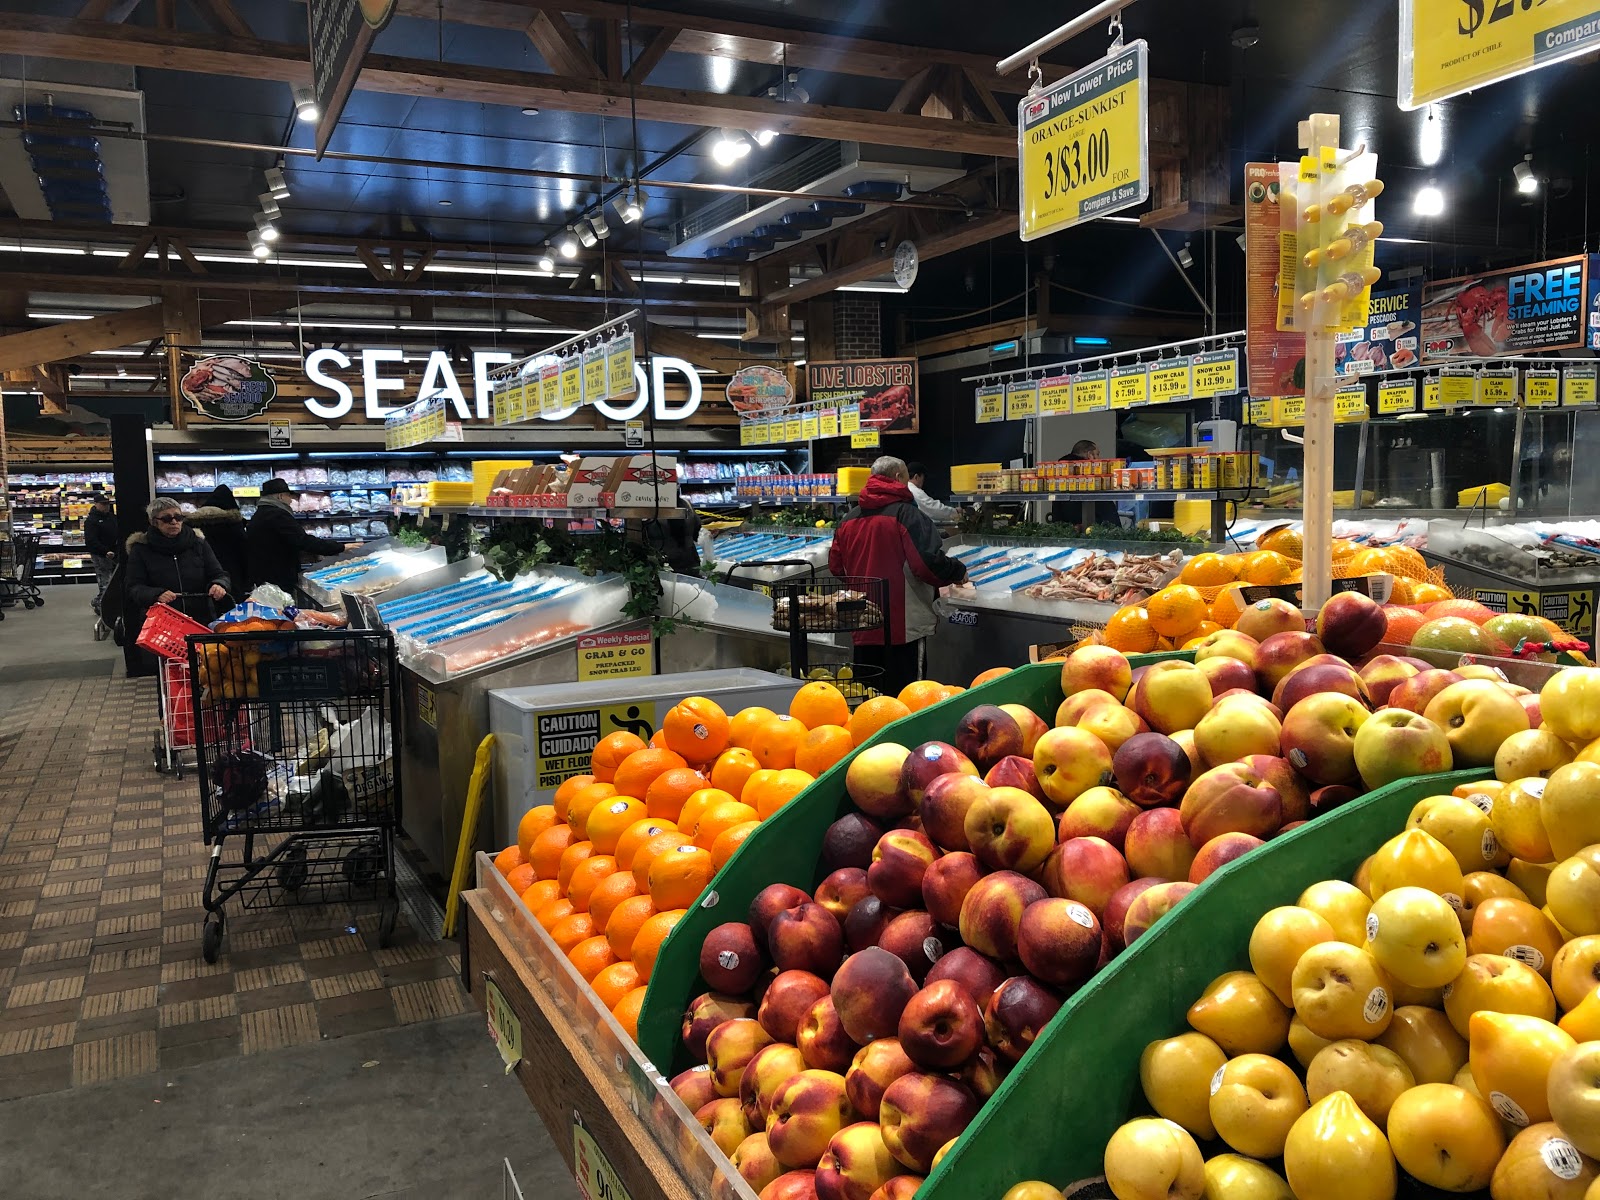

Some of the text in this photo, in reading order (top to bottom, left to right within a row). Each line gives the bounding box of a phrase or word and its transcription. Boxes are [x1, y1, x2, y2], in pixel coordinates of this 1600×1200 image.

[1441, 42, 1503, 70] PRODUCT OF CHILE
[1051, 58, 1134, 109] New Lower Price
[1032, 90, 1127, 144] ORANGE-SUNKIST
[1068, 128, 1086, 141] LARGE
[1044, 128, 1110, 200] 3/$3.00
[1112, 168, 1130, 184] FOR
[1084, 186, 1134, 212] Compare & Save
[1508, 265, 1581, 305] FREE
[1369, 294, 1409, 314] SERVICE
[1508, 298, 1579, 320] STEAMING
[1370, 313, 1397, 324] PESCADOS
[1520, 320, 1536, 328] steam
[1372, 330, 1376, 339] 5
[1595, 334, 1598, 346] 2
[1397, 340, 1401, 349] 6
[1346, 364, 1350, 373] 4
[812, 364, 912, 388] LIVE LOBSTER
[1196, 379, 1200, 387] $
[1204, 376, 1224, 386] 13.99
[241, 381, 267, 392] FRESH
[1160, 382, 1179, 391] 13.99
[224, 392, 262, 403] SEAFOOD
[812, 392, 832, 400] FRESH
[1122, 388, 1135, 397] 7.99
[1477, 592, 1506, 603] CAUTION
[1544, 596, 1568, 606] CAUTION
[951, 614, 977, 624] SEAFOOD
[1544, 609, 1568, 619] CUIDADO
[624, 633, 650, 642] Special
[585, 650, 614, 660] GRAB
[540, 713, 597, 733] CAUTION
[541, 736, 598, 756] CUIDADO
[545, 756, 592, 770] WET FLOO
[356, 772, 393, 793] ORGANC
[540, 775, 561, 787] PISO
